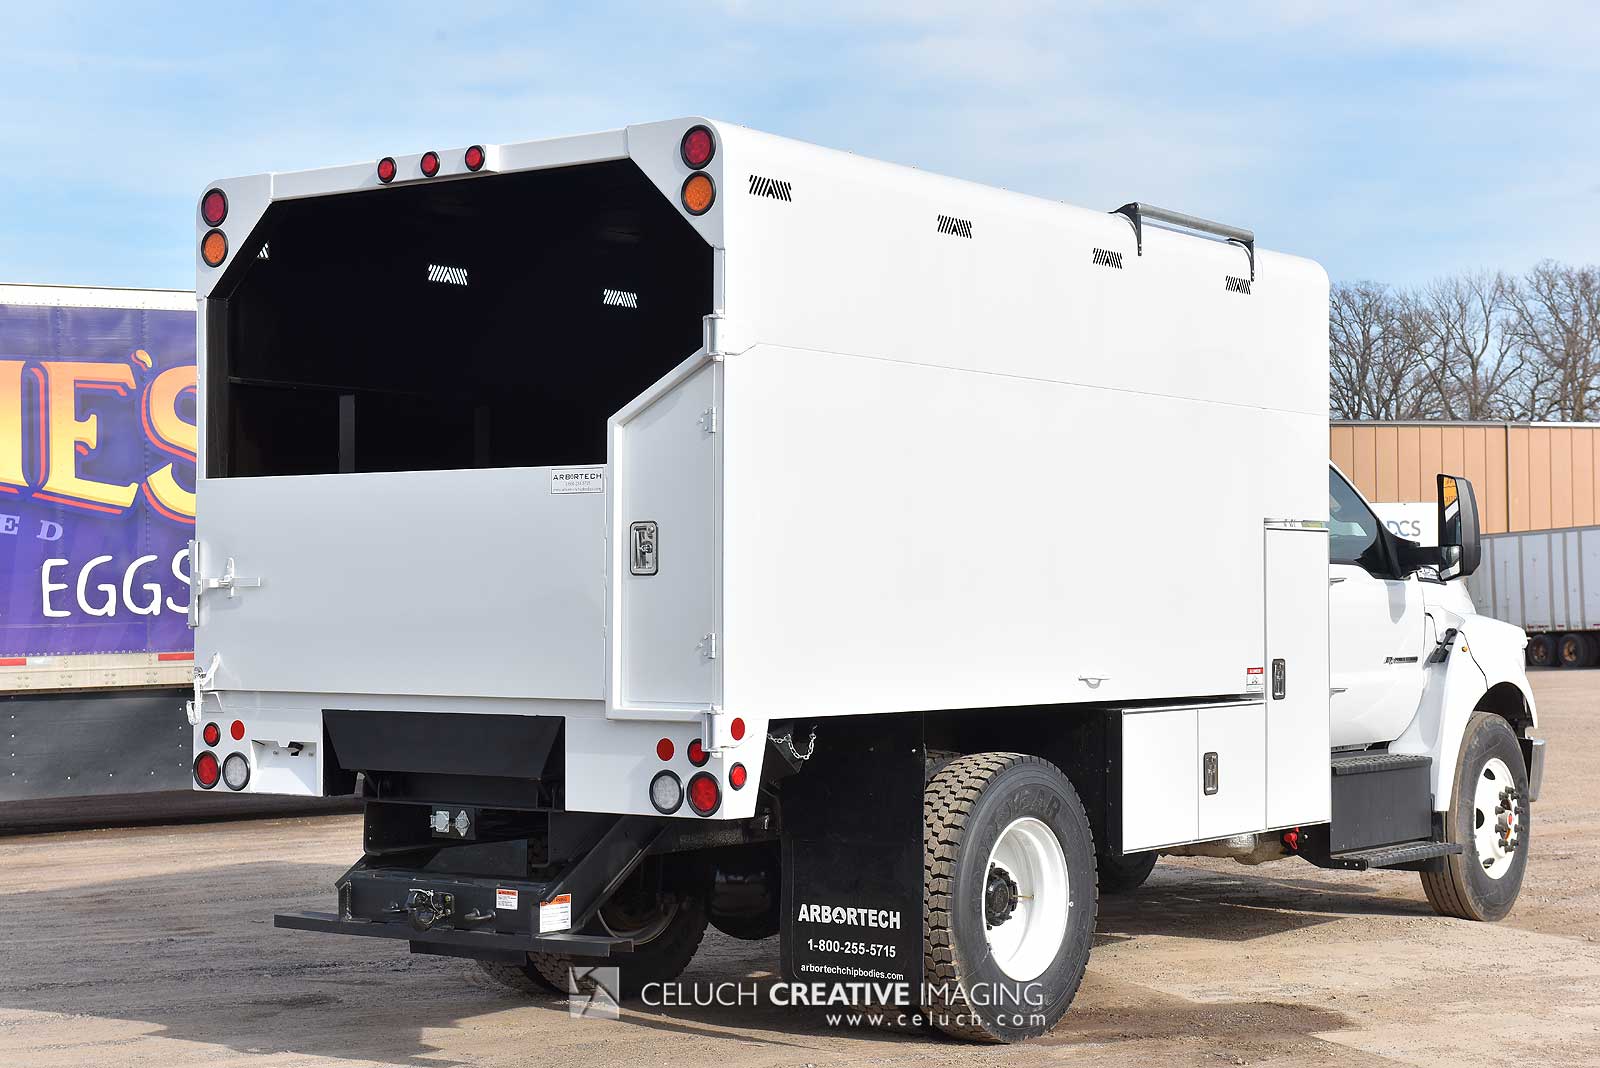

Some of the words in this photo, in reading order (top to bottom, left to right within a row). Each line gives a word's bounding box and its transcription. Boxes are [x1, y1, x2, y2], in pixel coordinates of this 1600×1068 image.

[41, 546, 190, 617] EGGS
[798, 903, 901, 930] ARBORTECH
[807, 938, 896, 958] 1-800-255-5715
[800, 963, 904, 981] arbortechchipbodies.com
